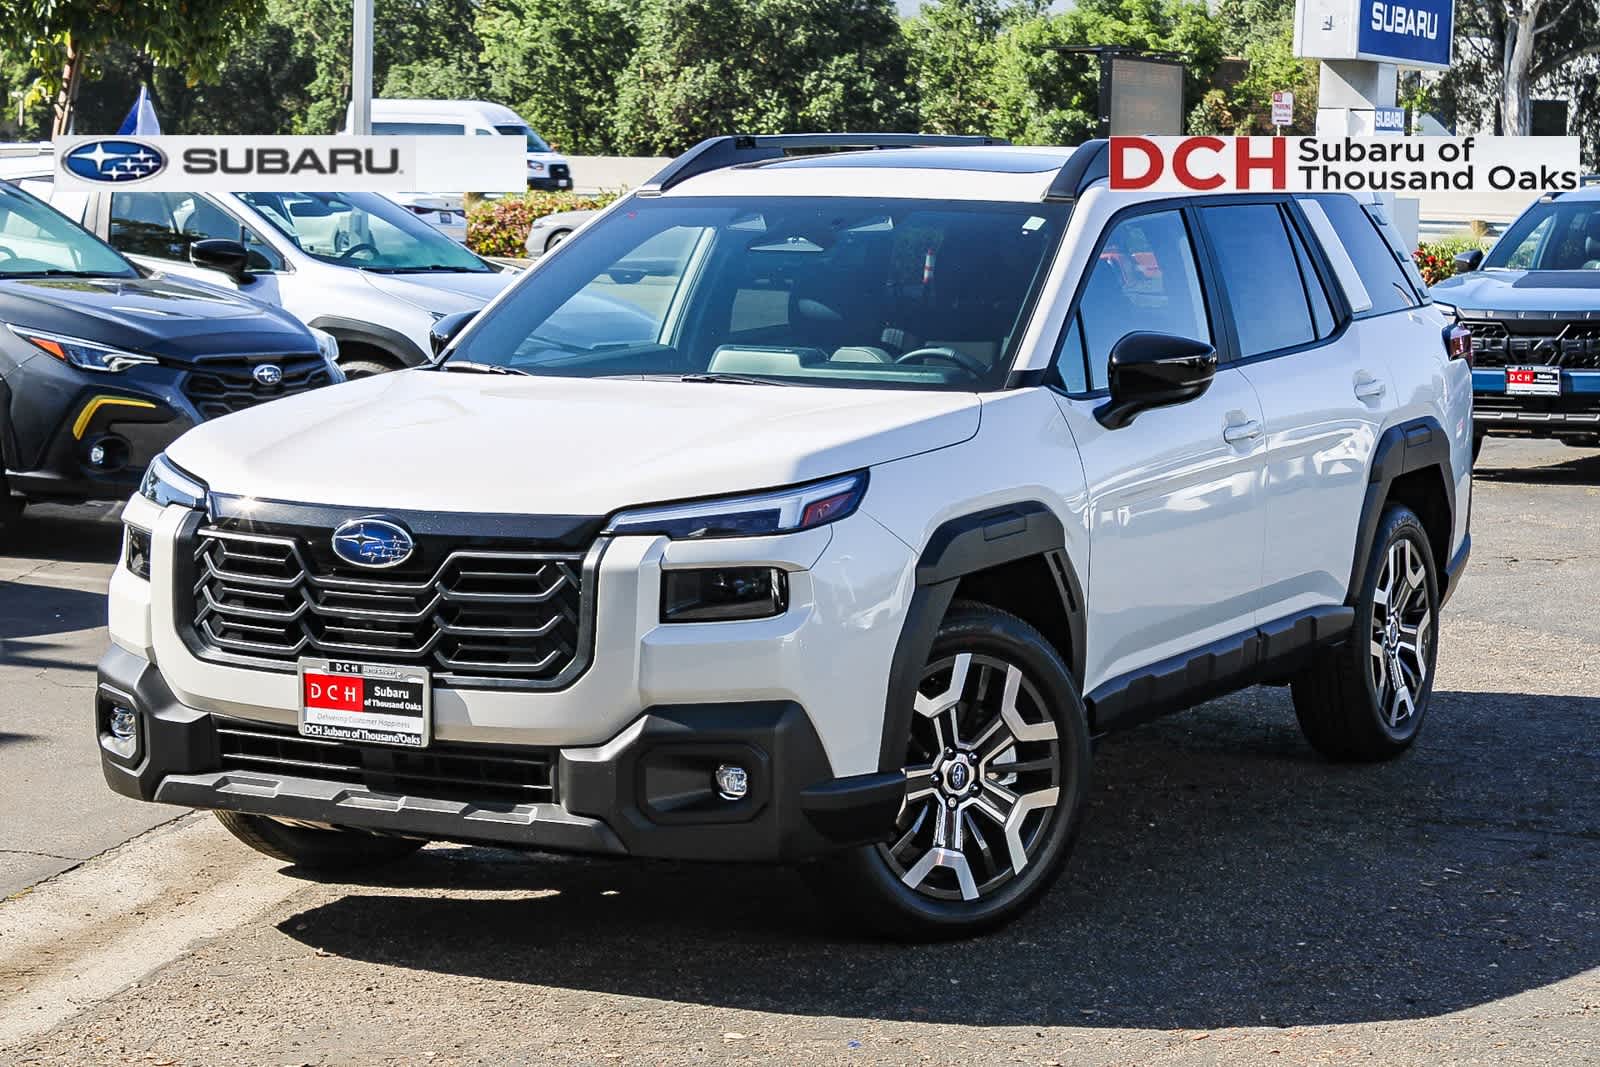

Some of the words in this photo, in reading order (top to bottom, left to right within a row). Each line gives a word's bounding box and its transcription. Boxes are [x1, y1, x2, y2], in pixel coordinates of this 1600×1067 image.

[1372, 1, 1438, 40] SUBARU
[1375, 110, 1404, 128] SUBARU
[310, 682, 356, 702] DCH
[374, 686, 409, 699] Subaru
[364, 698, 372, 706] of
[372, 699, 405, 710] Thousand
[404, 702, 421, 711] Oaks
[304, 724, 322, 735] DCH
[323, 726, 351, 738] Subaru
[351, 729, 361, 739] of
[399, 734, 421, 745] Oaks
